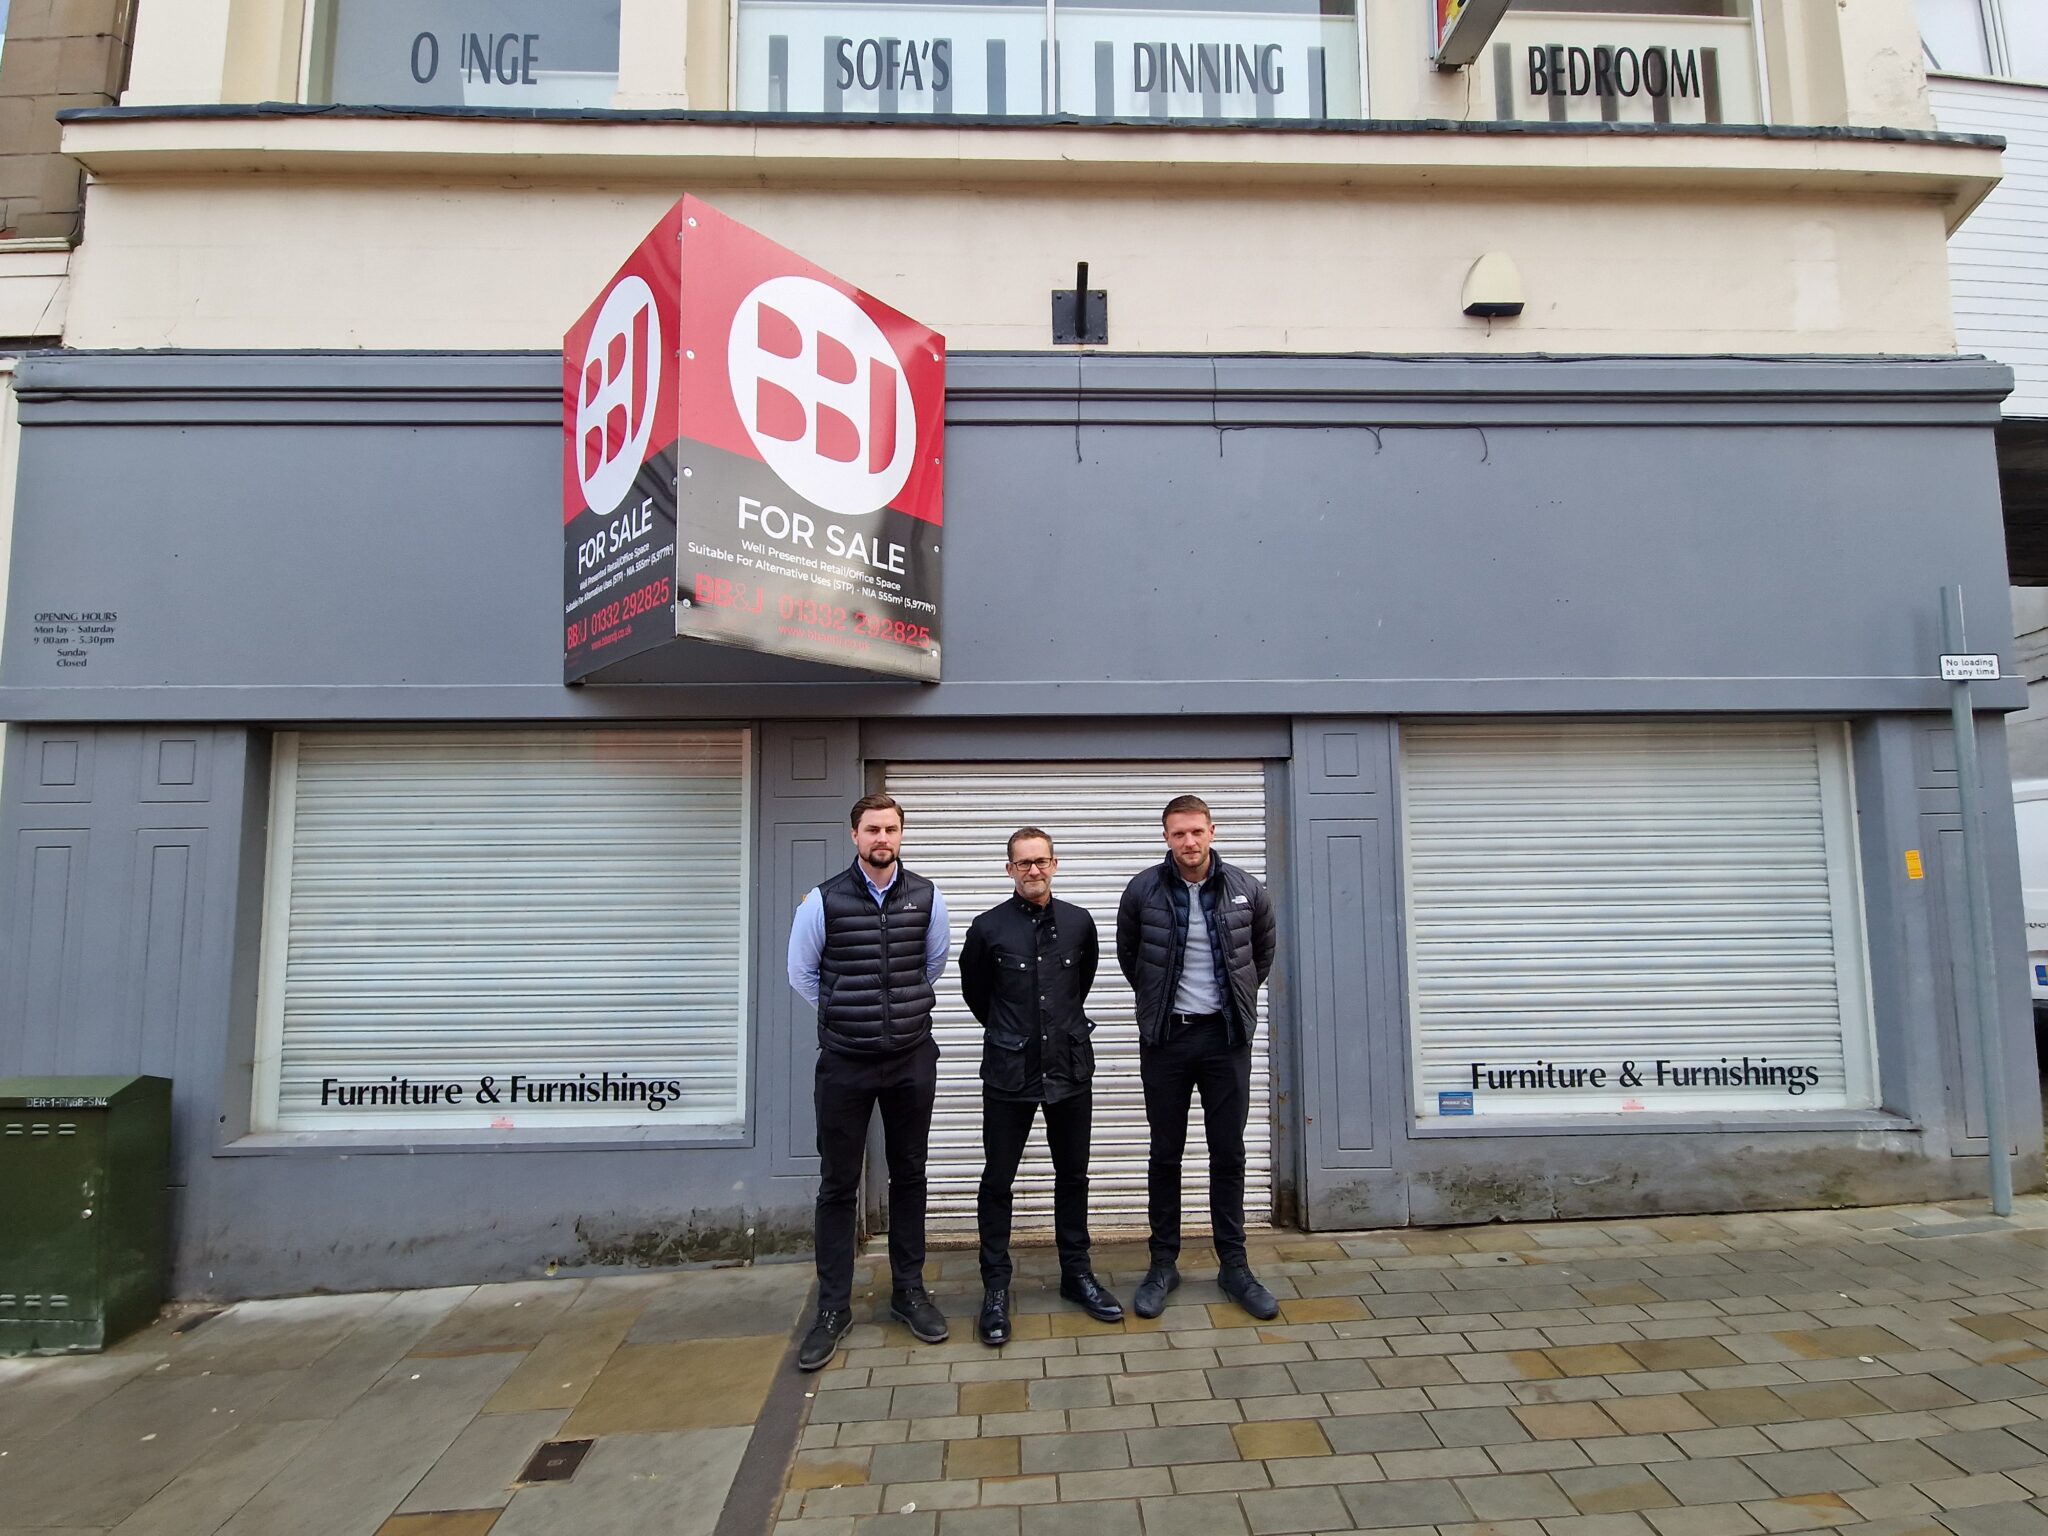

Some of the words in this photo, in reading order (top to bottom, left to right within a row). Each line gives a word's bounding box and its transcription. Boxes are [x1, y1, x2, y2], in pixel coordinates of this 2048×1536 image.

[836, 38, 950, 92] SOFA'S
[1133, 42, 1284, 95] DINNING
[1528, 46, 1700, 98] BEDROOM
[578, 530, 606, 575] FOR
[609, 497, 653, 553] SALE
[738, 495, 815, 549] FOR
[825, 524, 906, 575] SALE
[688, 541, 734, 562] Suitable
[736, 554, 754, 567] For
[755, 560, 809, 581] Alternative
[810, 572, 832, 587] Uses
[833, 579, 855, 595] (STP)
[862, 587, 876, 599] NIA
[741, 539, 765, 555] Well
[768, 547, 818, 569] Presented
[820, 561, 875, 585] Retail/Office
[876, 576, 901, 591] Space
[34, 612, 78, 621] OPENING
[81, 612, 118, 621] HOURS
[78, 625, 115, 634] Saturday
[591, 601, 620, 636] 01332
[622, 576, 670, 621] 292825
[694, 573, 765, 615] BB&J
[777, 594, 849, 631] 01332
[852, 610, 931, 649] 292825
[56, 659, 88, 668] Closed
[57, 648, 88, 657] Sunday
[1958, 669, 1973, 677] any
[1961, 658, 1994, 667] loading
[321, 1075, 463, 1106] Furniture
[475, 1076, 501, 1104] &
[510, 1072, 681, 1111] Furnishings
[1471, 1060, 1607, 1090] Furniture
[1619, 1060, 1643, 1088] &
[1657, 1057, 1819, 1096] Furnishings
